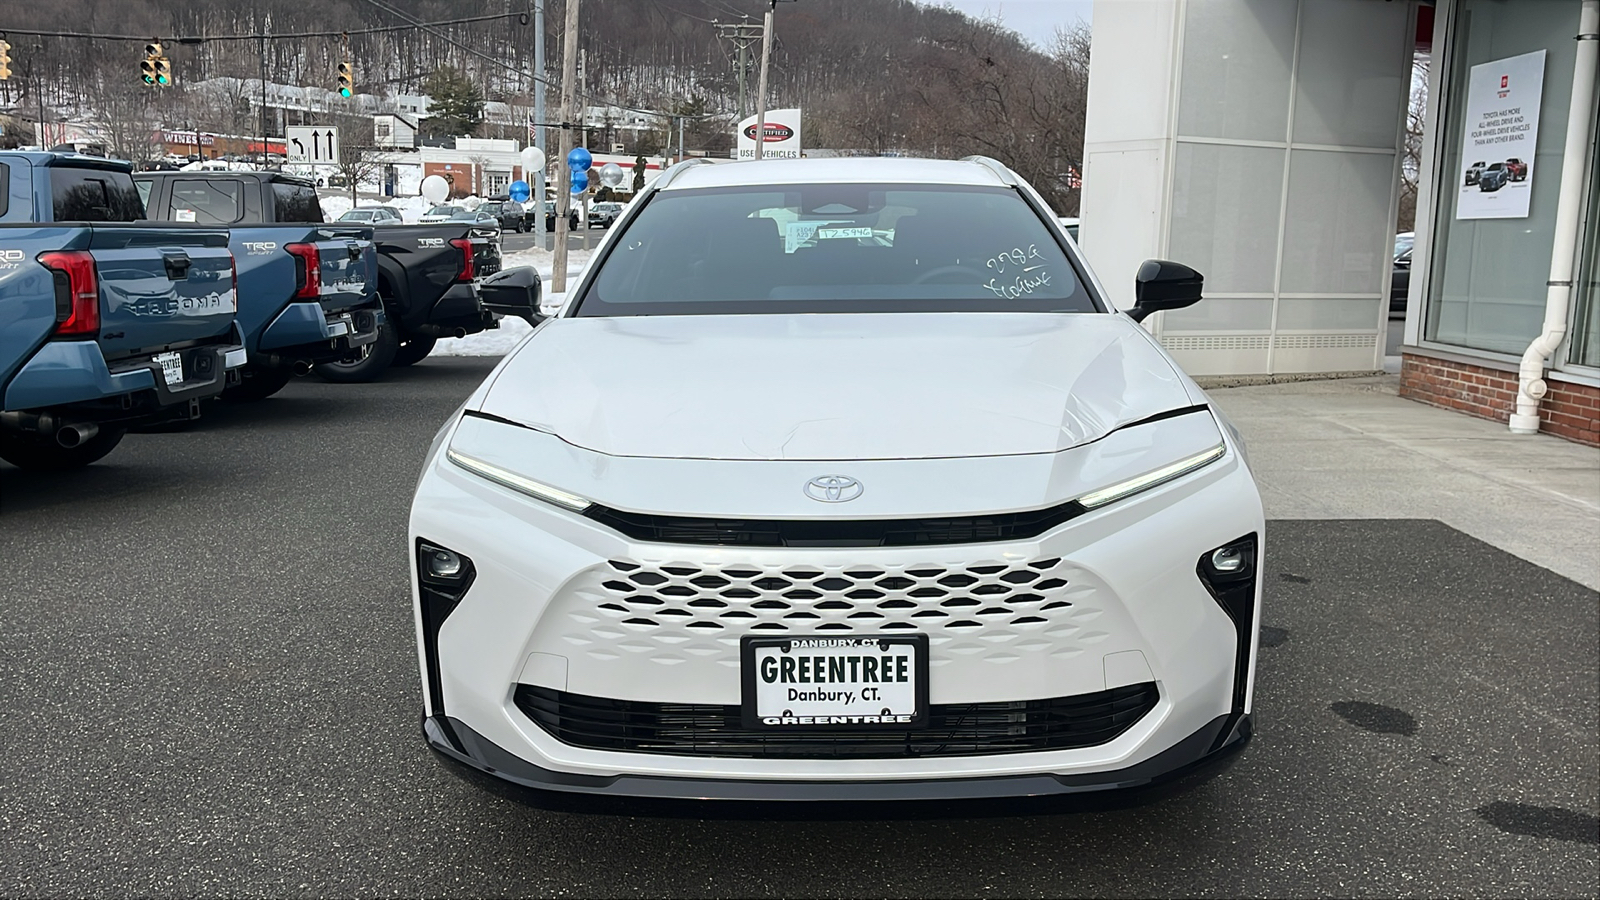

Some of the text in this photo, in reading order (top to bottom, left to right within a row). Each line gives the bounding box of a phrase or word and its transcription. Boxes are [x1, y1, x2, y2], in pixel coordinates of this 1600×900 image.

[1483, 107, 1521, 119] TOYOTA HAS MORE
[1501, 118, 1513, 126] DRIVE
[1513, 116, 1524, 124] AND
[1497, 127, 1510, 136] DRIVE
[1510, 123, 1531, 134] VEHICLES
[164, 134, 197, 144] WINES
[1475, 137, 1485, 146] THAN
[1486, 136, 1494, 145] ANY
[1495, 134, 1509, 144] OTHER
[740, 150, 797, 159] USE VEHICLES
[242, 242, 277, 251] TRD
[130, 295, 220, 315] TACOMA
[790, 639, 858, 649] DANBURY,
[760, 655, 909, 684] GREENTREE
[788, 687, 881, 705] Danbury, CT.
[762, 715, 912, 725] GREENTREE
